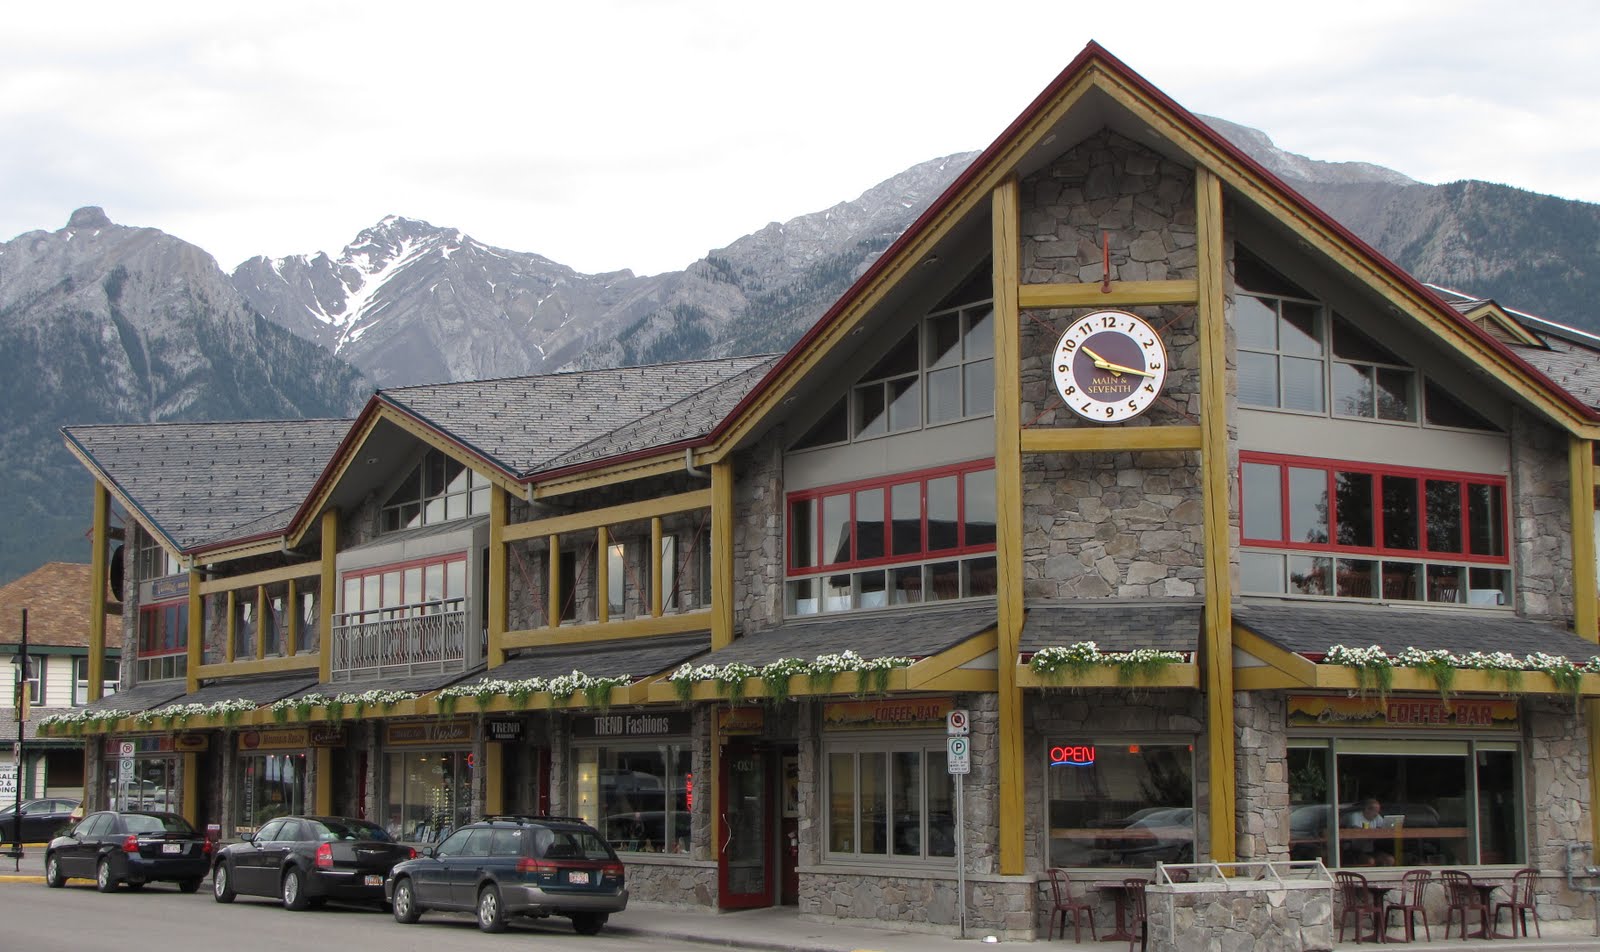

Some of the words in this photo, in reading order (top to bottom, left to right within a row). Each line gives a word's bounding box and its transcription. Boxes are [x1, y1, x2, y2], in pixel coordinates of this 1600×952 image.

[1101, 317, 1116, 328] 12
[1128, 323, 1136, 332] 1
[1079, 322, 1093, 335] 11
[1062, 339, 1076, 353] 10
[1143, 339, 1154, 349] 2
[1058, 364, 1069, 372] 9
[1150, 362, 1161, 370] 3
[1092, 377, 1118, 385] MAIN
[1065, 386, 1075, 395] 8
[1088, 385, 1131, 394] SEVENTH
[1144, 384, 1154, 393] 4
[1081, 402, 1092, 412] 7
[1128, 400, 1138, 412] 5
[1106, 407, 1114, 417] 6
[874, 706, 912, 721] COFFEE
[917, 704, 939, 719] BAR
[1385, 703, 1449, 724] COFFEE
[1456, 704, 1492, 725] BAR
[491, 722, 520, 733] TREND
[594, 716, 623, 735] TREND
[626, 715, 669, 735] Fashions
[955, 742, 962, 751] P
[1050, 746, 1095, 762] OPEN
